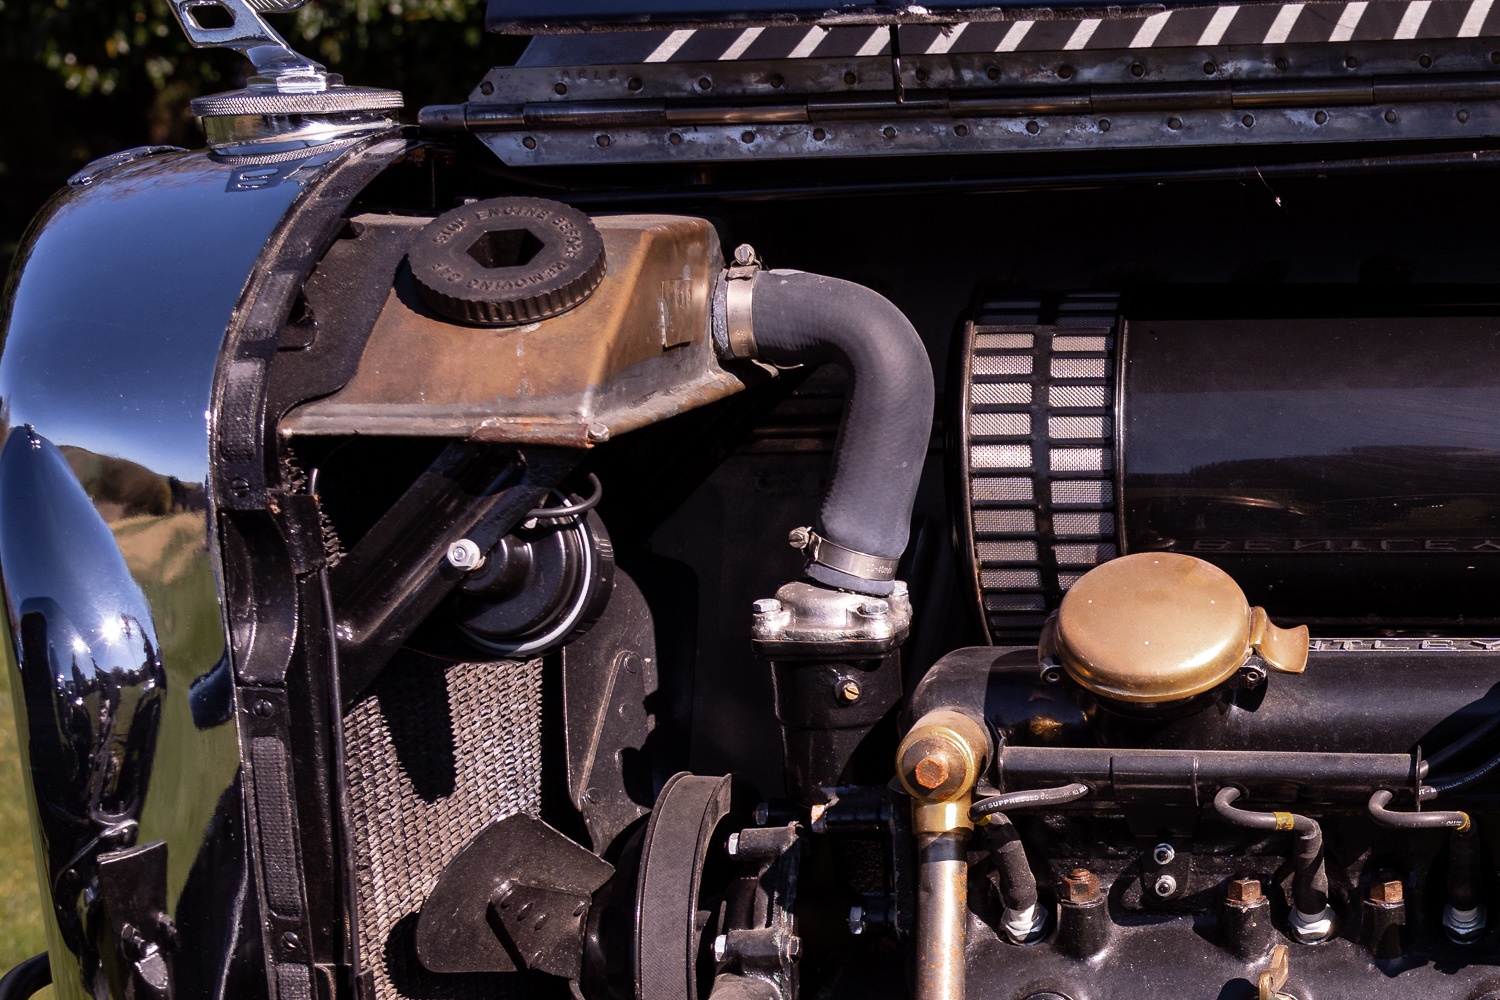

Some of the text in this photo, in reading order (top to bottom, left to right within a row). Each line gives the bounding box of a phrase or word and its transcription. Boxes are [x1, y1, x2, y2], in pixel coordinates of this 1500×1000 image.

[432, 206, 584, 291] STOP ENGINE BEFORE REMOVING CAP
